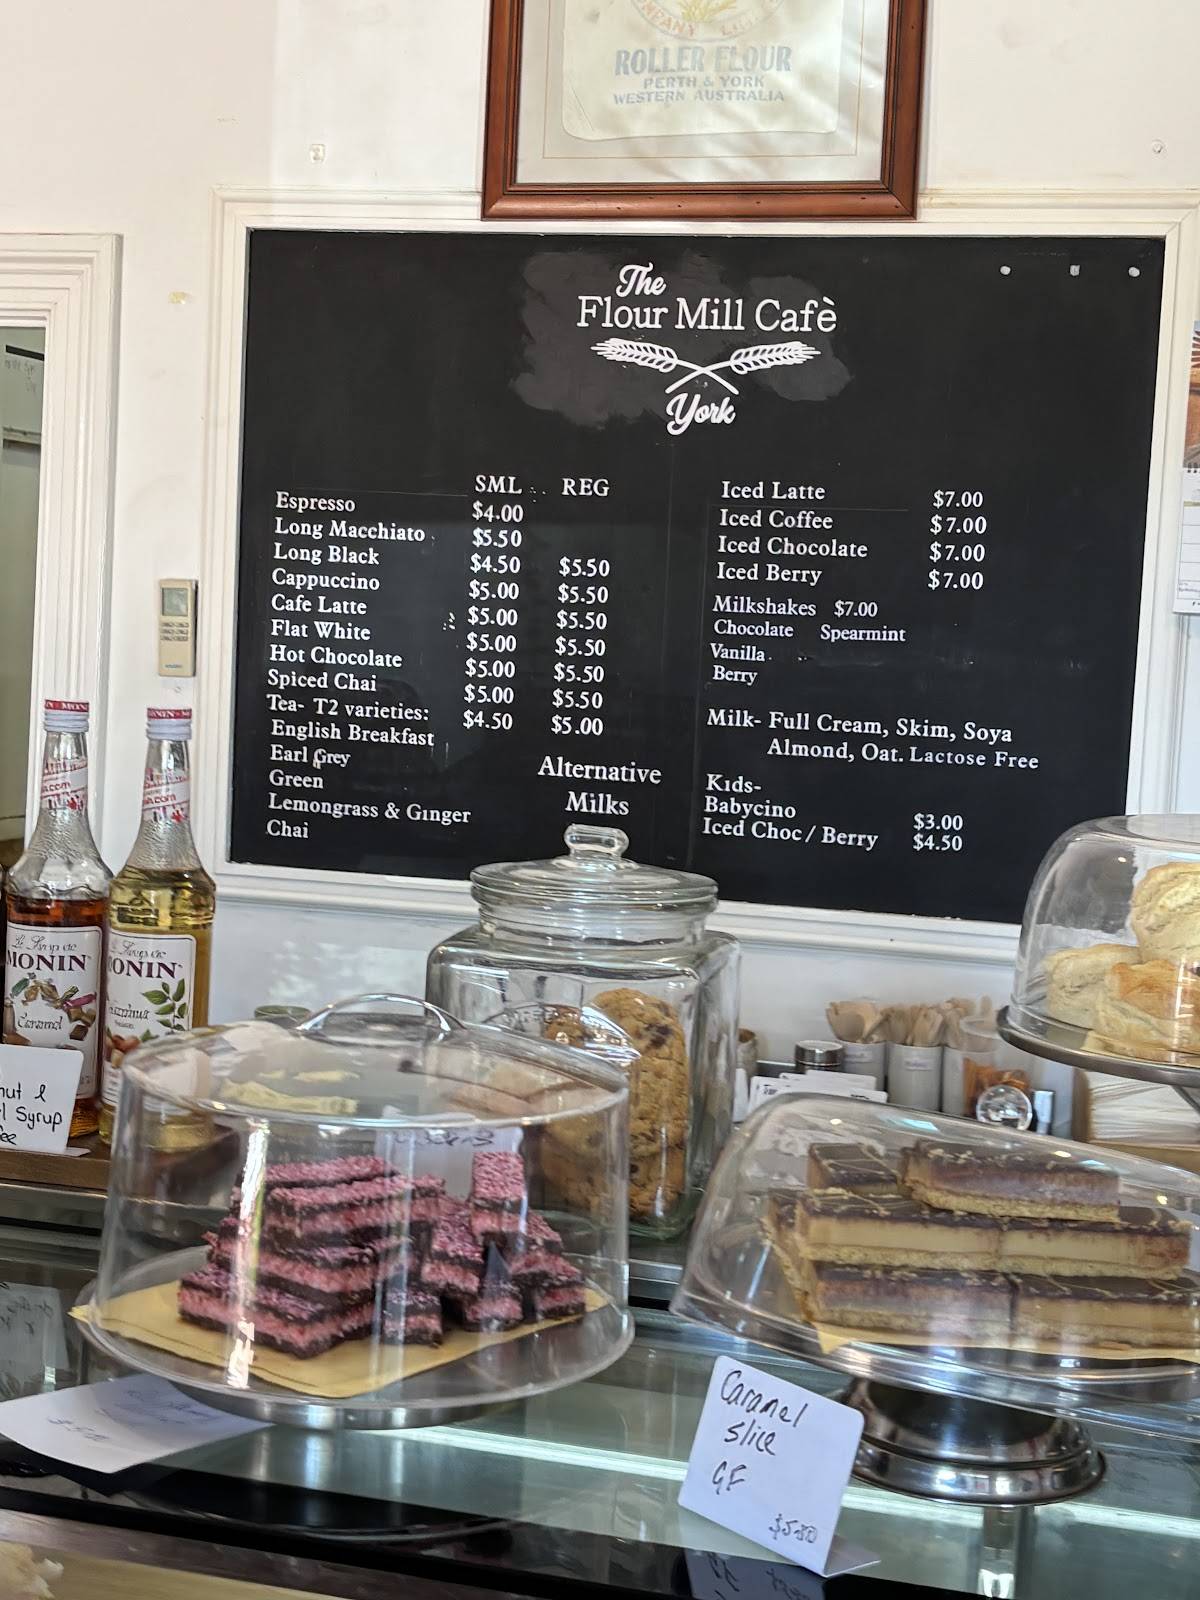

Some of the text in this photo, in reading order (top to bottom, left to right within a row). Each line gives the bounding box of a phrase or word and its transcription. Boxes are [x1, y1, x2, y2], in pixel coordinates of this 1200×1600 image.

[614, 46, 793, 76] ROLLER FLOUR
[613, 89, 785, 105] WESTERN AUSTRALIA
[643, 75, 765, 90] PERTH & YORK
[615, 262, 667, 298] The
[576, 295, 837, 333] Flour Mill Cafè
[665, 392, 736, 436] York
[474, 474, 610, 497] SML REG
[721, 480, 984, 509] Iced Latte $7.00
[275, 490, 524, 523] Espresso $4.00
[719, 508, 987, 536] Iced Coffee $7.00
[274, 516, 523, 549] Long Macchiato $5.50
[273, 541, 611, 578] Long Black $4.50 $5.50
[717, 535, 986, 563] Iced Chocolate $7.00
[271, 567, 609, 605] Cappuccino $5.00 $5.50
[716, 561, 984, 591] Iced Berry $7.00
[271, 593, 608, 631] Cafe Latte $5.00 $5.50
[712, 594, 878, 618] Milkshakes $7.00
[270, 618, 606, 657] Flat White $5.00 $5.50
[713, 618, 906, 643] Chocolate Spearmint
[269, 643, 605, 684] Hot Chocolate $5.00 $5.50
[710, 642, 766, 662] Vanilla
[267, 668, 603, 710] Spiced Chai $5.00 $5.50
[712, 664, 758, 686] Berry
[266, 693, 604, 736] Tea- T2 varieties: $4.50 $5.00
[706, 708, 1012, 746] Milk- Full Cream, Skim, Soya
[271, 718, 435, 747] English Breakfast
[270, 743, 351, 770] Earl Grey
[766, 737, 855, 763] Almond,
[909, 746, 986, 766] Lactose
[994, 751, 1039, 769] Free
[269, 768, 324, 789] Green
[537, 755, 662, 785] Alternative
[268, 792, 472, 826] Lemongrass & Ginger
[564, 790, 629, 816] Milks
[704, 795, 964, 831] Babycino $3.00
[266, 819, 309, 839] Chai
[703, 816, 745, 837] Iced
[751, 820, 803, 841] Choc
[820, 825, 879, 852] Berry
[912, 832, 963, 852] $4.50
[15, 1105, 63, 1133] Syrup
[720, 1369, 809, 1428] Caramel
[711, 1460, 748, 1496] GF
